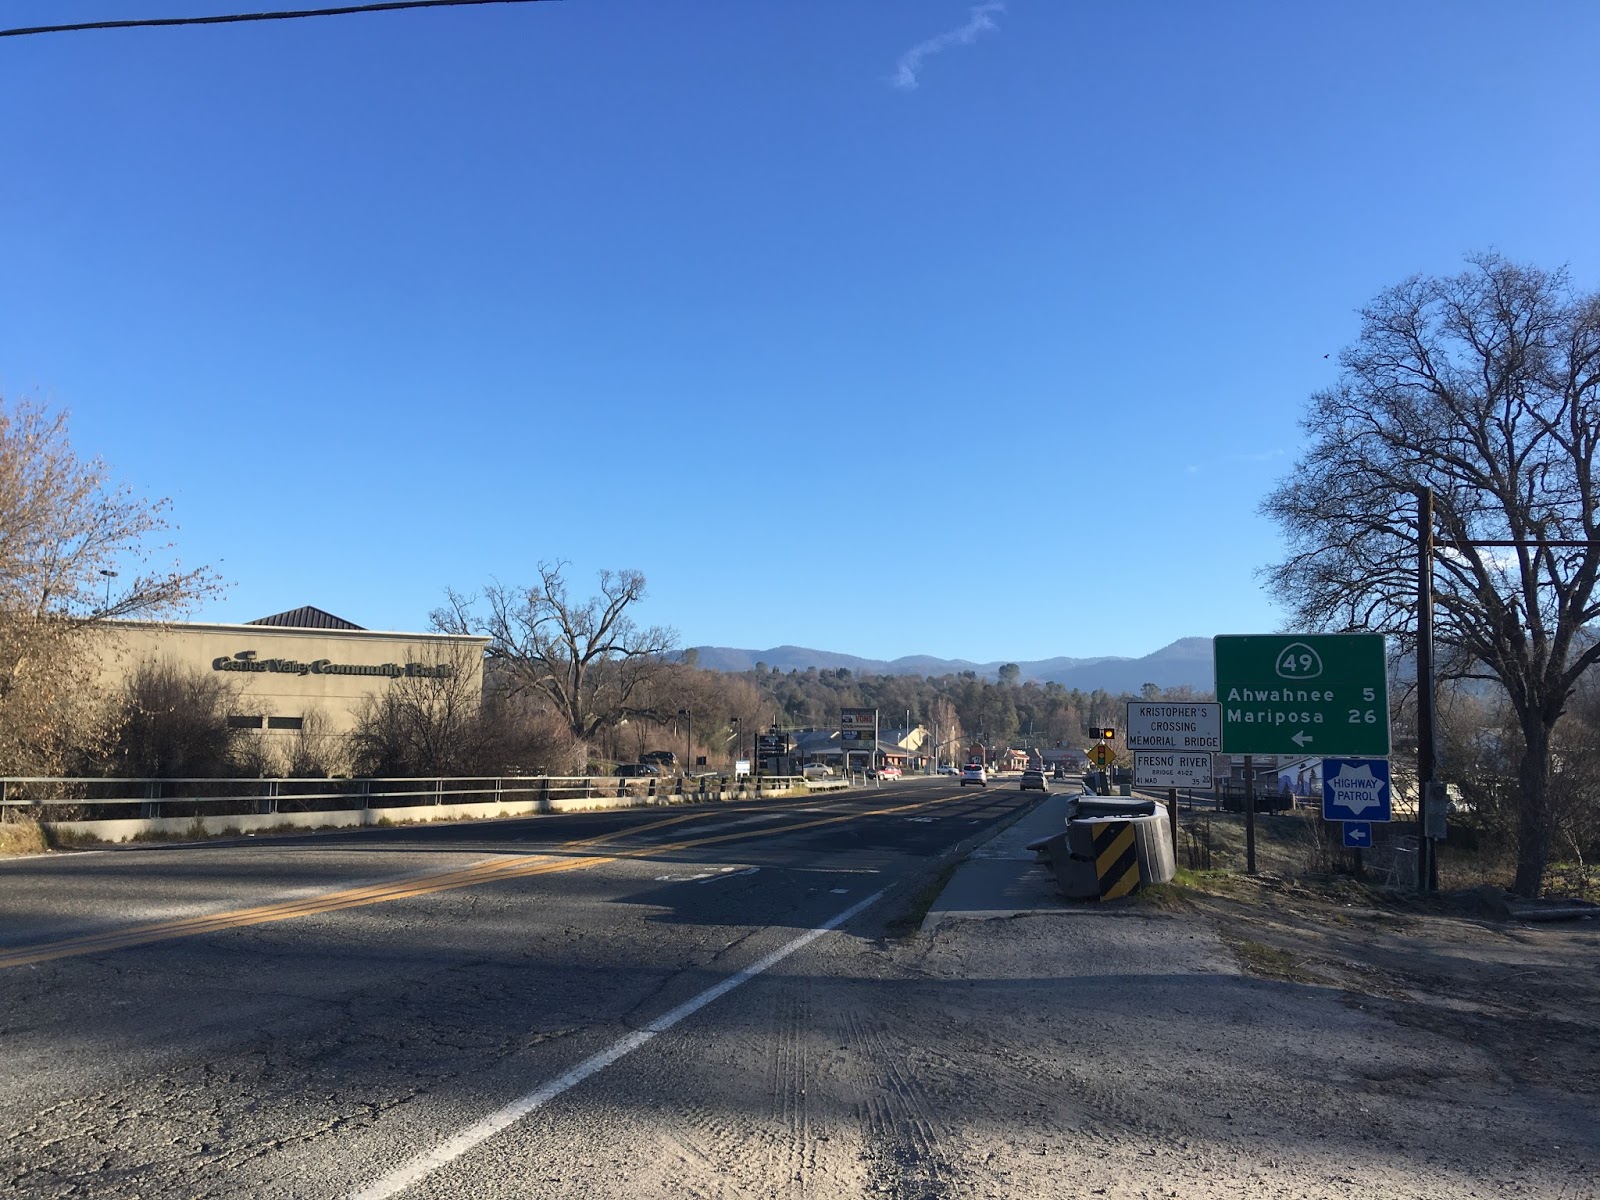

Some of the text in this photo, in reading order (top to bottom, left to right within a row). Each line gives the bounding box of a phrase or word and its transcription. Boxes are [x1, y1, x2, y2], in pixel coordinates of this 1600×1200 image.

[220, 656, 270, 672] Central
[274, 658, 313, 677] Valley
[318, 658, 405, 679] Community
[1282, 654, 1313, 672] 49
[1227, 687, 1376, 702] Ahwahnee 5
[1139, 707, 1208, 718] KRISTOPHER'S
[1227, 708, 1377, 727] Mariposa 26
[1150, 721, 1197, 732] CROSSING
[1129, 735, 1219, 748] MEMORIAL BRIDGE
[1138, 756, 1208, 768] FRESNO RIVER
[1333, 778, 1378, 789] HIGHWAY
[1337, 790, 1376, 801] PATROL
